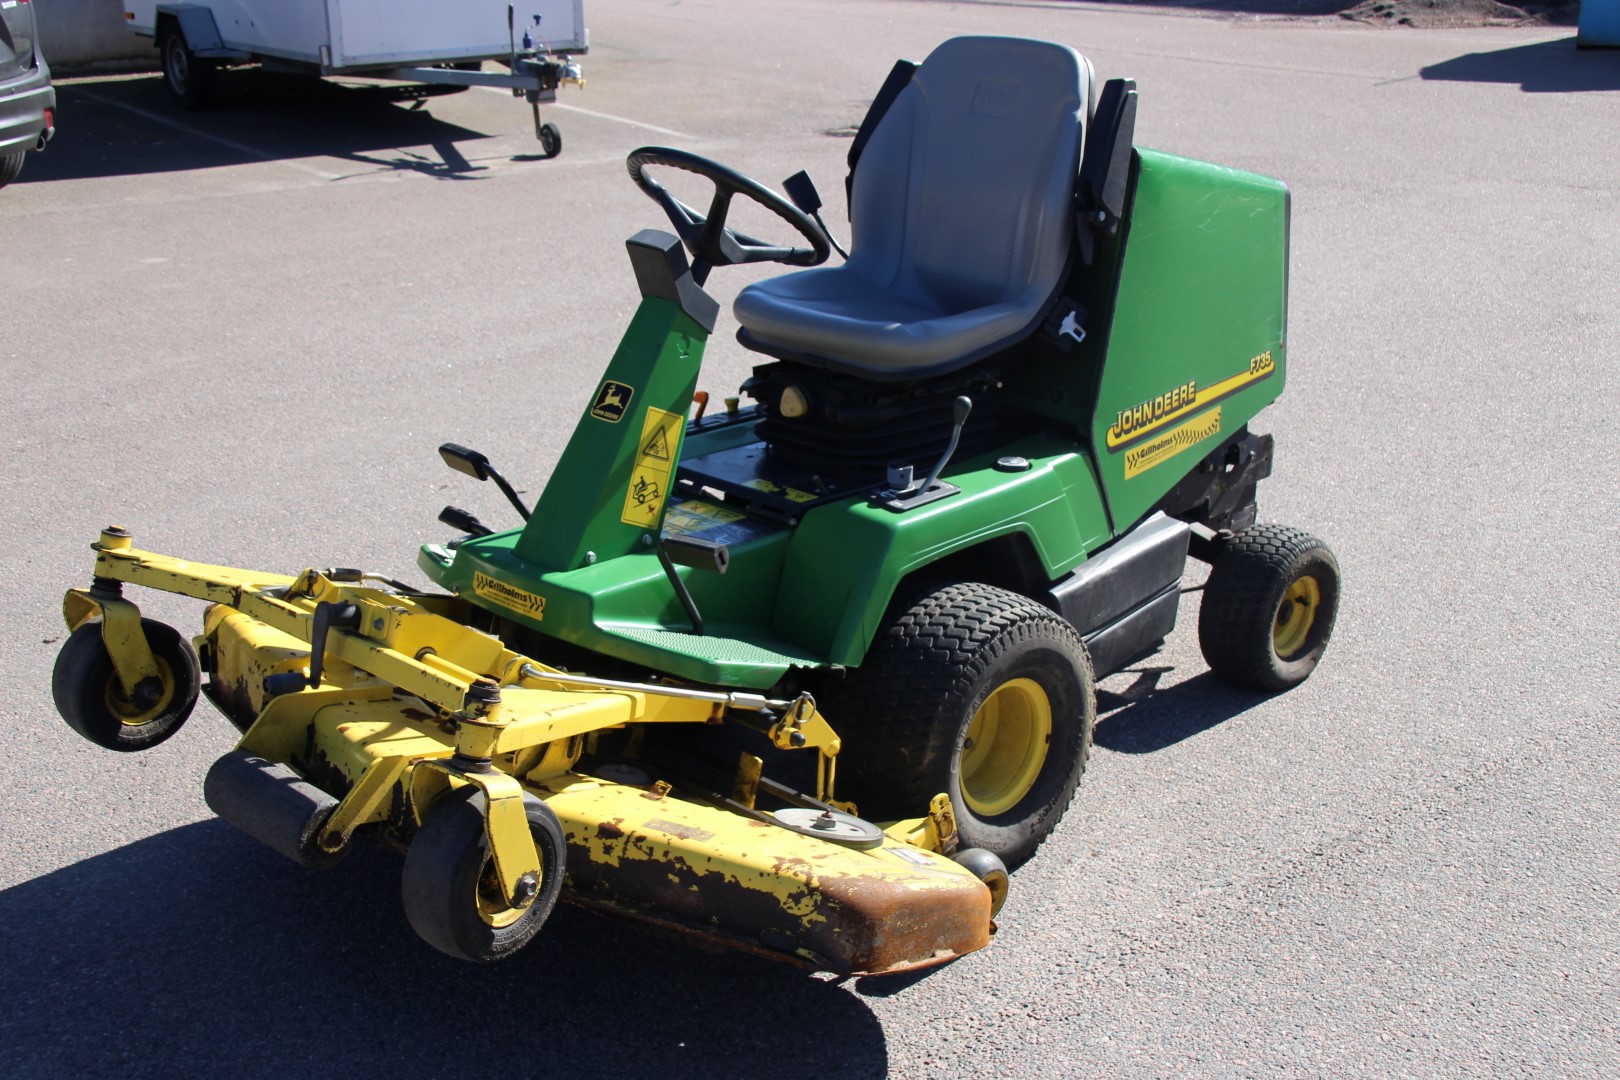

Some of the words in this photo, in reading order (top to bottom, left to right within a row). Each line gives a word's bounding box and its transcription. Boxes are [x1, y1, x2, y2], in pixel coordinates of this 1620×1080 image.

[1250, 350, 1271, 374] F735
[1113, 400, 1153, 438] JOHN
[1154, 380, 1196, 418] DEERE
[1140, 437, 1173, 459] Gillholms
[488, 580, 528, 602] Gillholms
